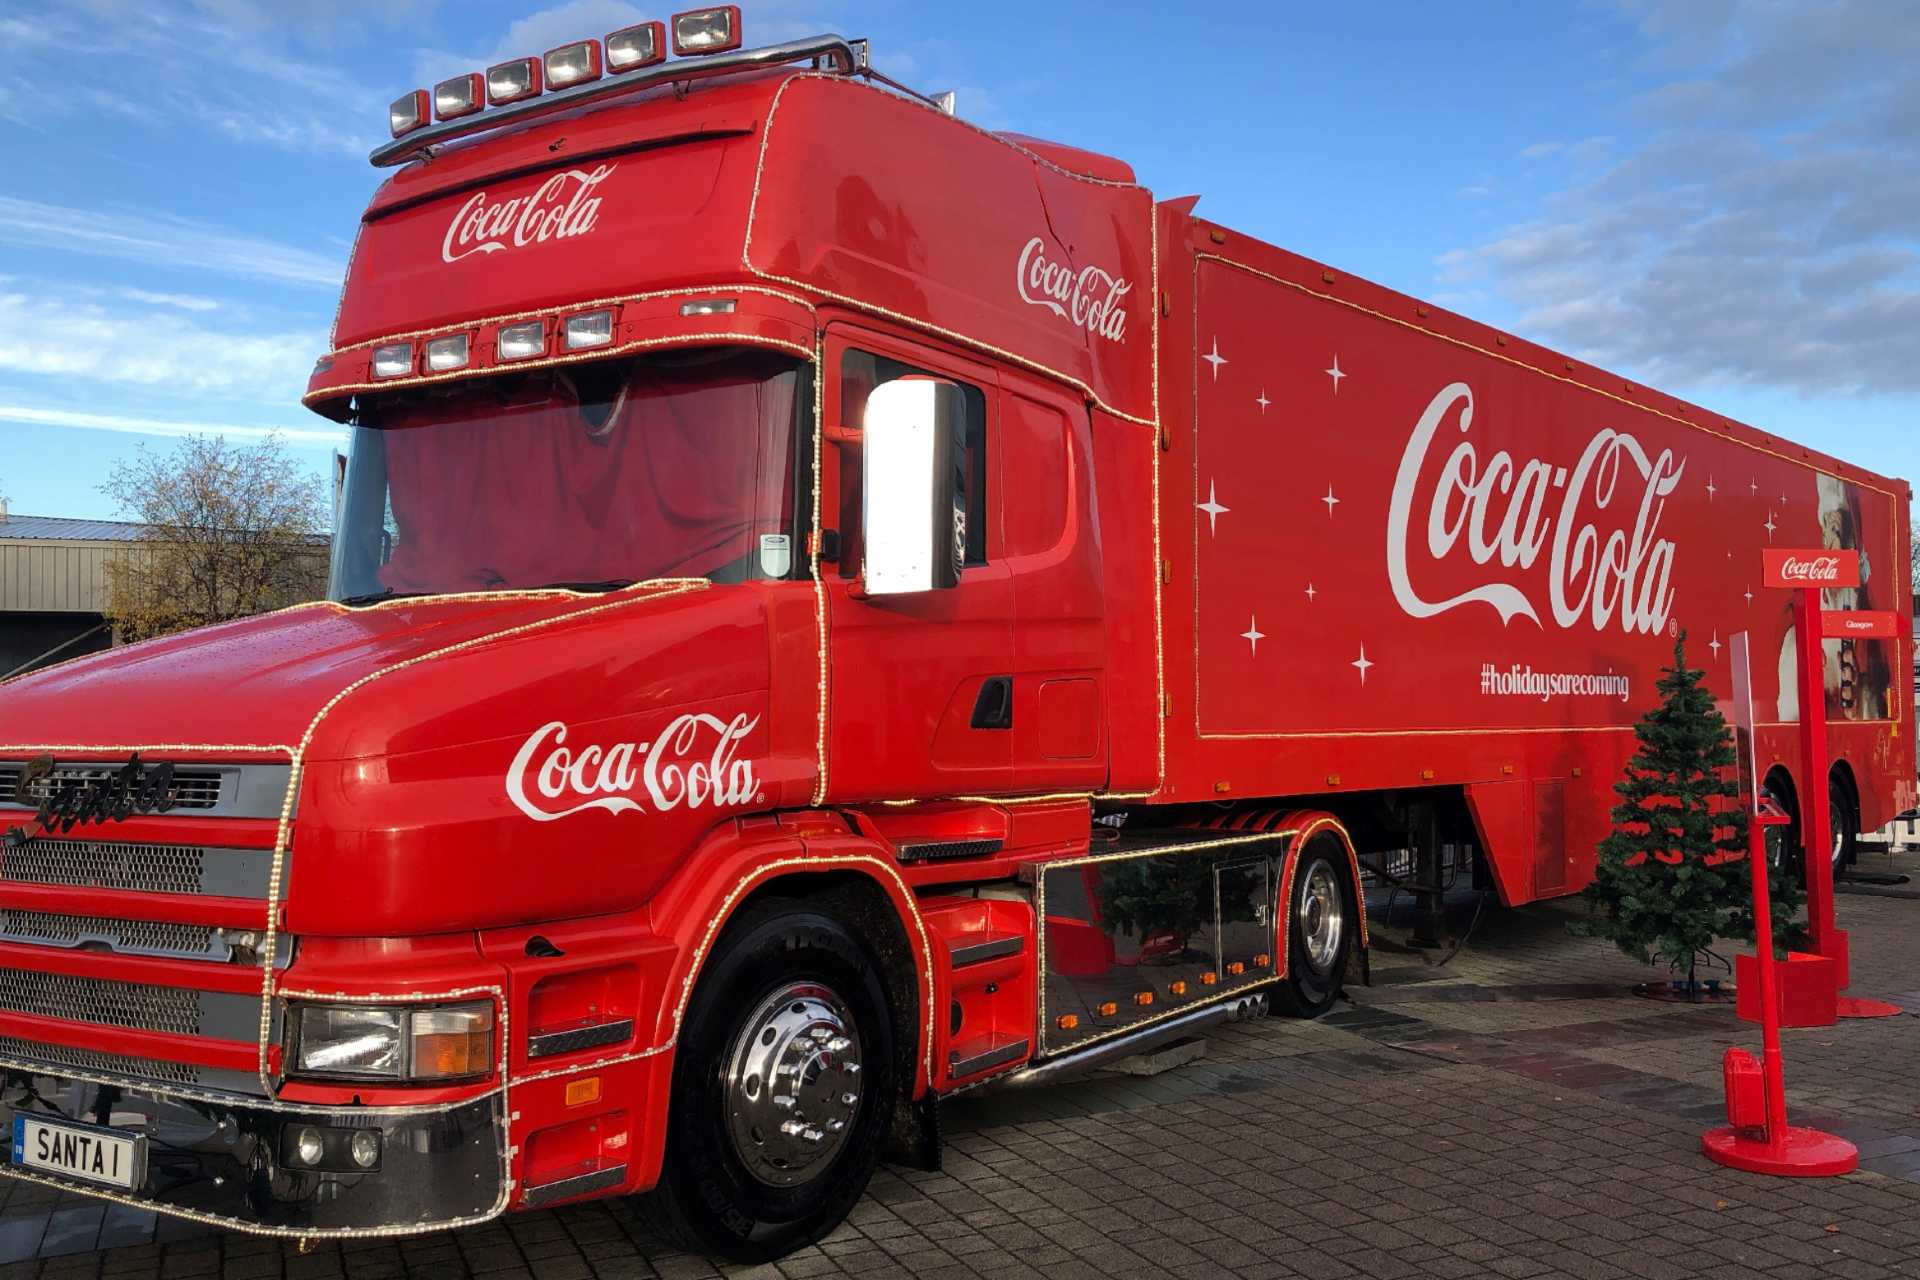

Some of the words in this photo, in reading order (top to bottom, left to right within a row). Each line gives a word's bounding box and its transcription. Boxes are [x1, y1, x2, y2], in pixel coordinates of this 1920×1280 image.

[442, 162, 619, 263] Coca-Cola
[1017, 237, 1133, 342] Coca-Cola
[1387, 382, 1686, 635] Coca-Cola
[1781, 556, 1840, 580] Coca-Cola
[1480, 663, 1629, 702] #holidaysarecoming
[505, 712, 761, 821] Coca-Cola
[38, 1128, 104, 1175] SANTA
